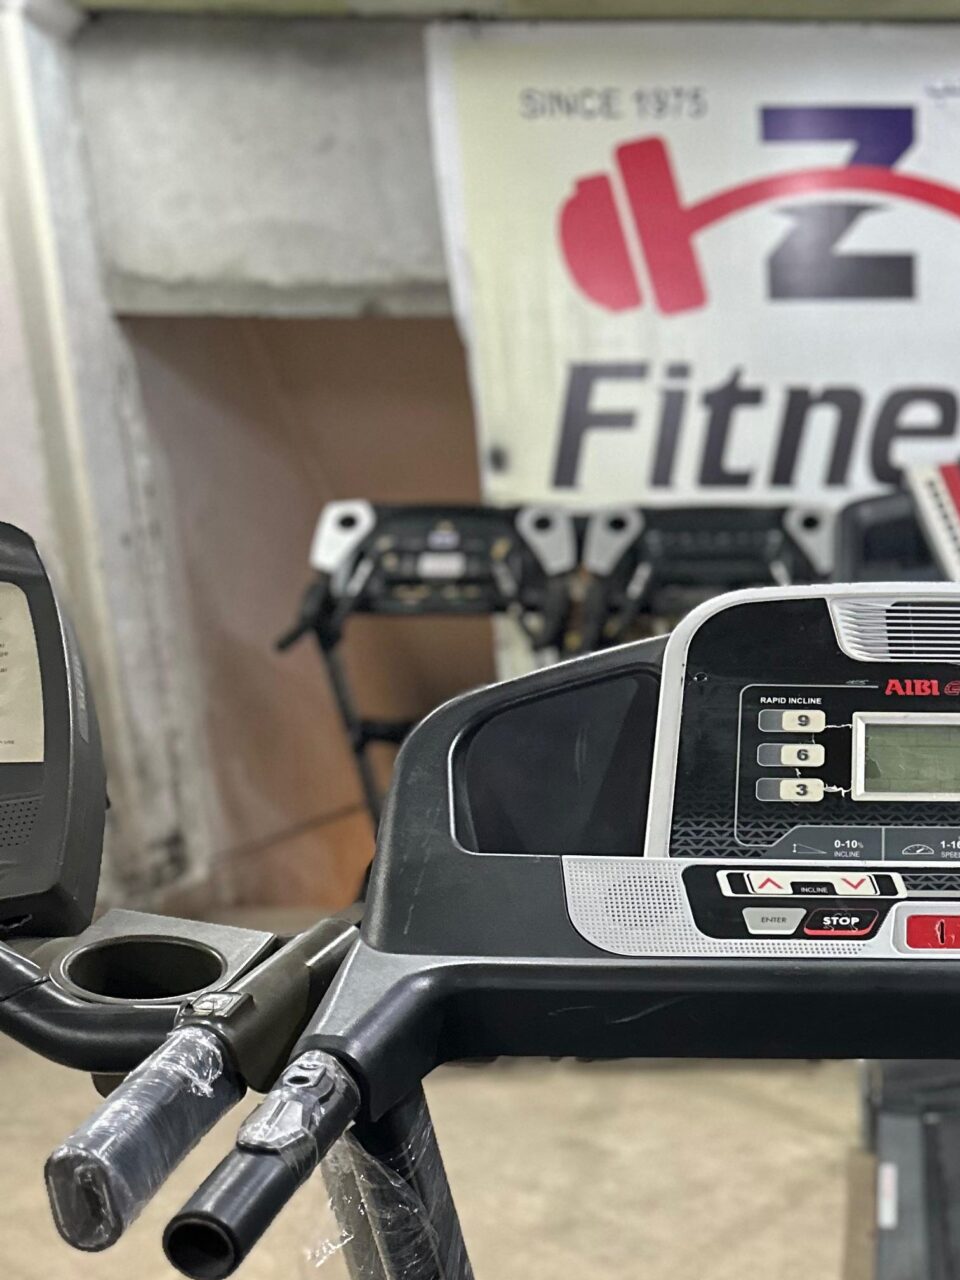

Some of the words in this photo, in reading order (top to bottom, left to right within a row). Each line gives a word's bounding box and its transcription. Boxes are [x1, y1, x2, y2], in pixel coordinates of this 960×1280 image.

[520, 87, 624, 120] SINCE
[632, 87, 709, 120] 1975
[788, 697, 822, 705] INCLINE
[797, 714, 810, 727] 9
[796, 748, 810, 761] 6
[795, 783, 808, 796] 3
[800, 886, 829, 894] INCLINE
[822, 916, 860, 926] STOP
